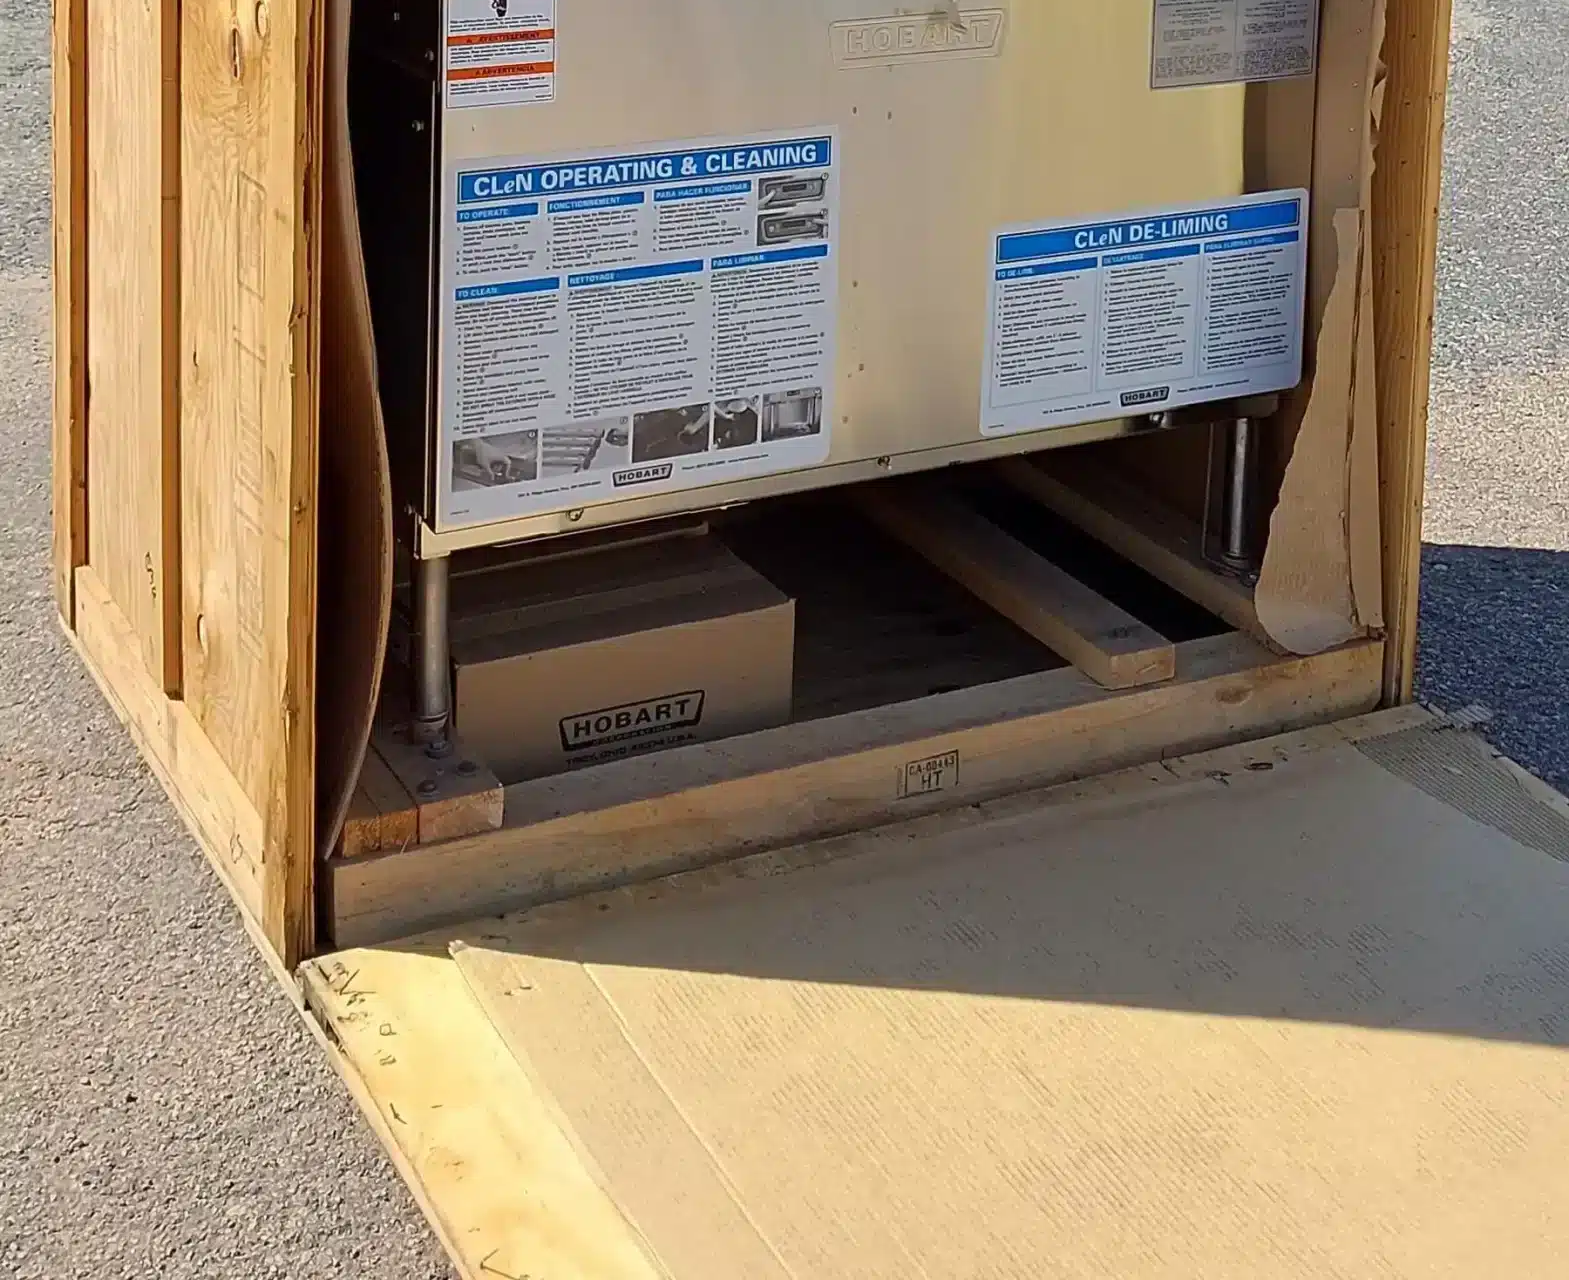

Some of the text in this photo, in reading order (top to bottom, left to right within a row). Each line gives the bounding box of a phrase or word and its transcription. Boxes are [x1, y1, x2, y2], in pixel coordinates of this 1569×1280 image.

[843, 18, 991, 55] HOBART
[473, 144, 818, 198] CLeN OPERATING & CLEANING
[459, 211, 471, 221] TO
[1073, 213, 1229, 249] CLeN DE-LIMING
[458, 289, 469, 298] TO
[1123, 389, 1166, 403] HOBART
[617, 466, 669, 483] HOBART
[573, 699, 691, 738] HOBART
[921, 769, 943, 789] HT
